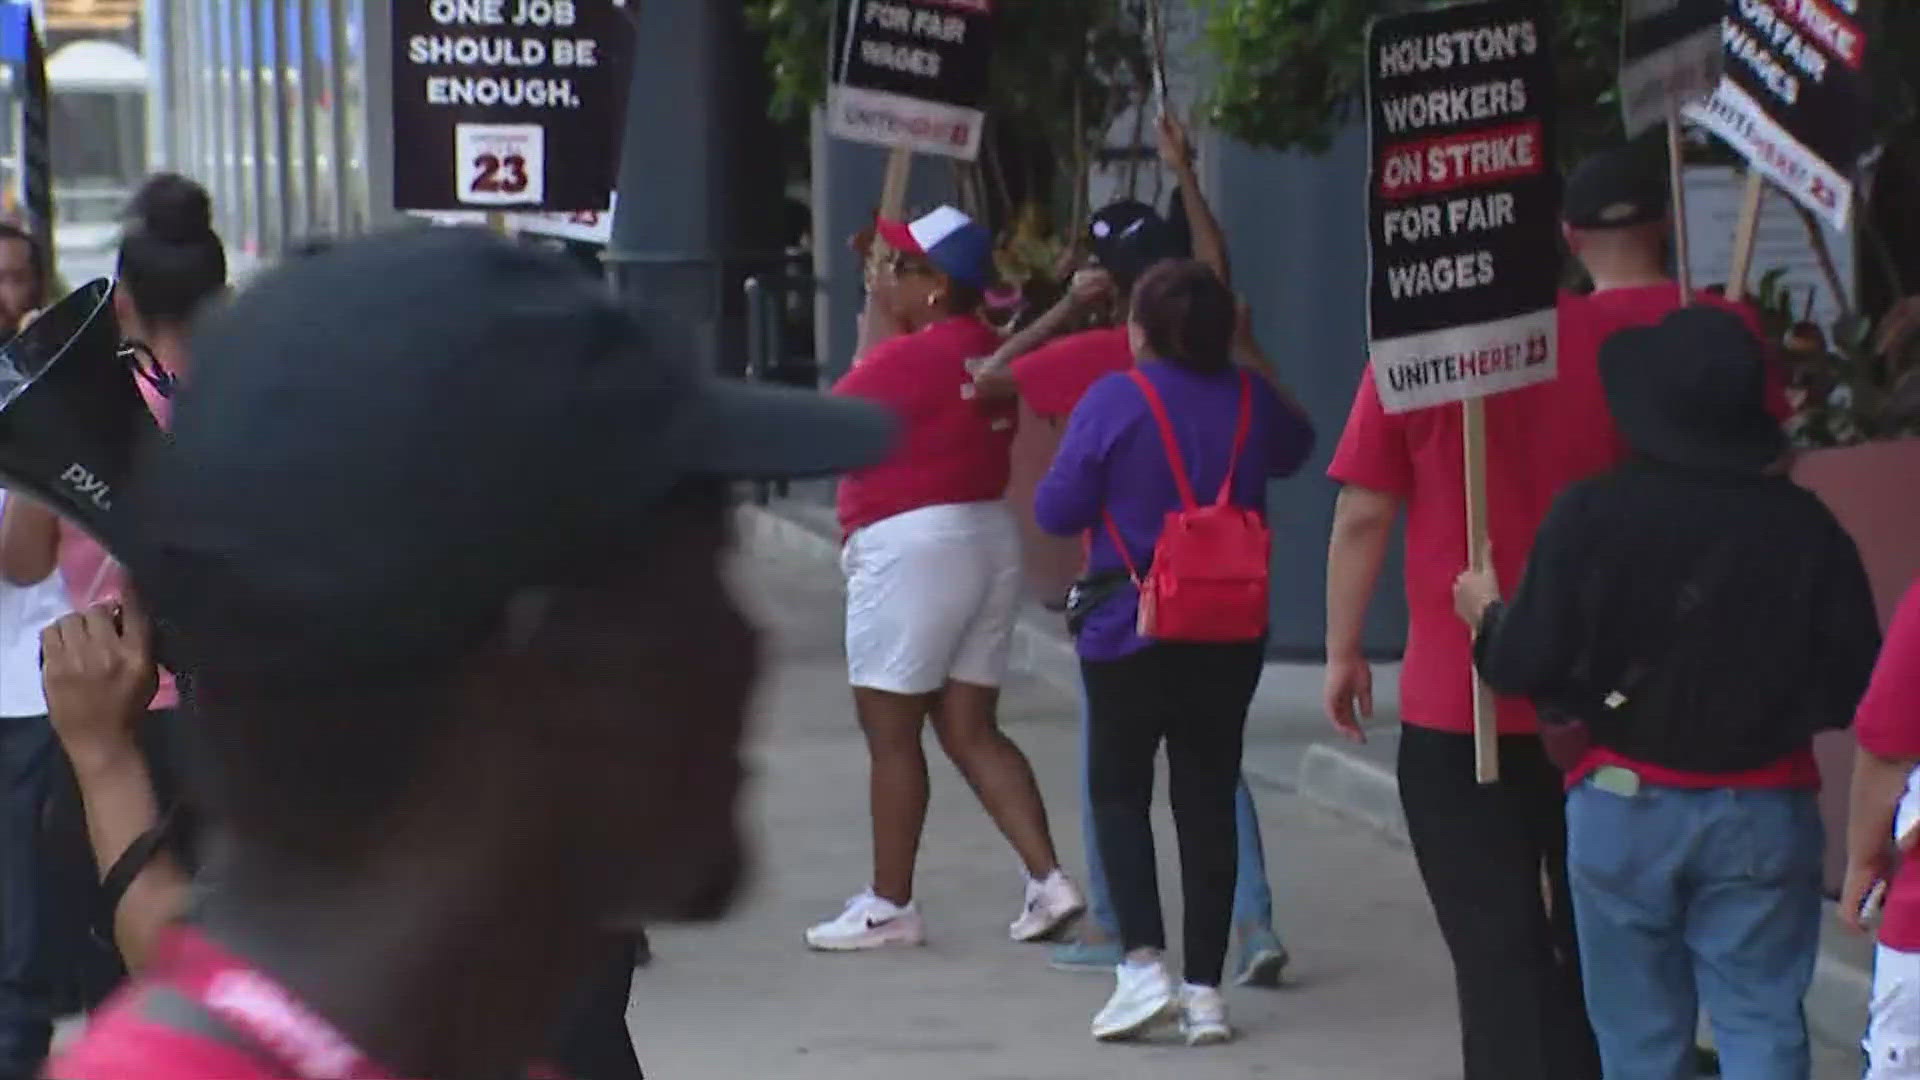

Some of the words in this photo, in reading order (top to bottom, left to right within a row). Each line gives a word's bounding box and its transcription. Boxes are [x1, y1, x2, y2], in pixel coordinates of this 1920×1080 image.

[429, 0, 503, 25] ONE
[511, 0, 576, 26] JOB
[408, 35, 546, 66] SHOULD
[552, 38, 598, 67] BE
[1380, 21, 1537, 78] HOUSTON'S
[427, 76, 580, 107] ENOUGH.
[1383, 78, 1527, 133] WORKERS
[471, 154, 528, 194] 23
[1384, 150, 1422, 188] ON
[1428, 133, 1534, 182] STRIKE
[1384, 203, 1441, 246] FOR
[1448, 192, 1515, 234] FAIR
[1388, 250, 1495, 300] WAGES
